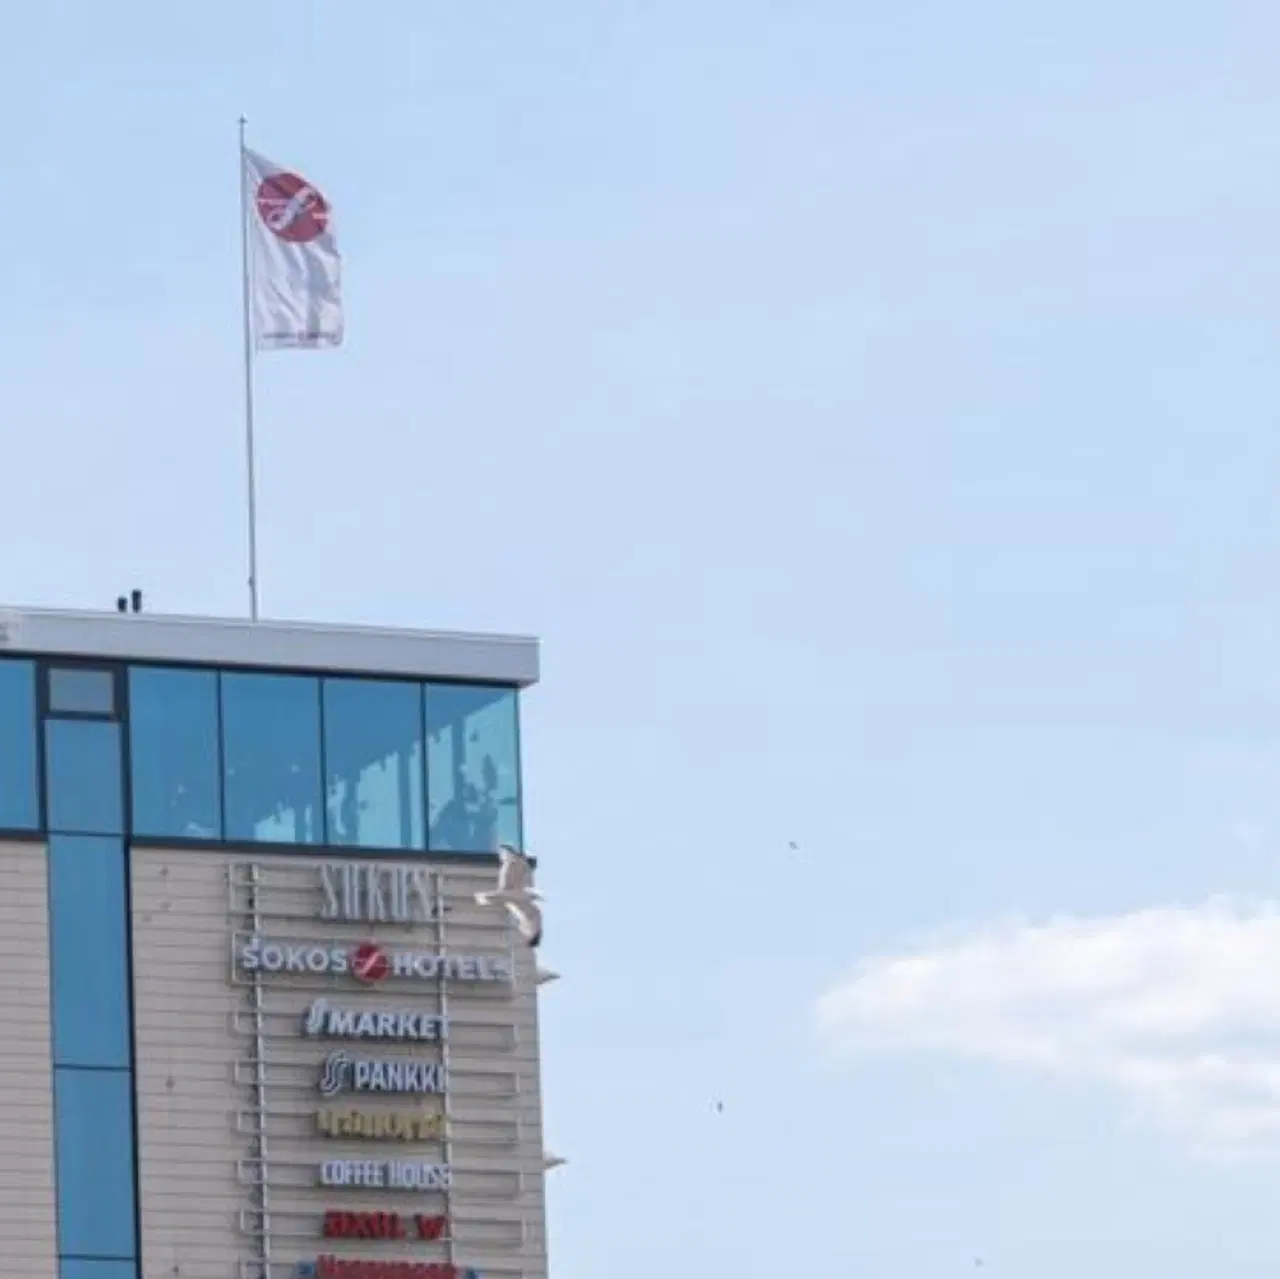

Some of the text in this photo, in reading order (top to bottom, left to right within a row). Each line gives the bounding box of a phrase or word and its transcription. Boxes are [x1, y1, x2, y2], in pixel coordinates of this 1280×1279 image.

[243, 944, 511, 981] SOKOS HOTELS
[321, 1160, 452, 1189] COFFEE HOUSE
